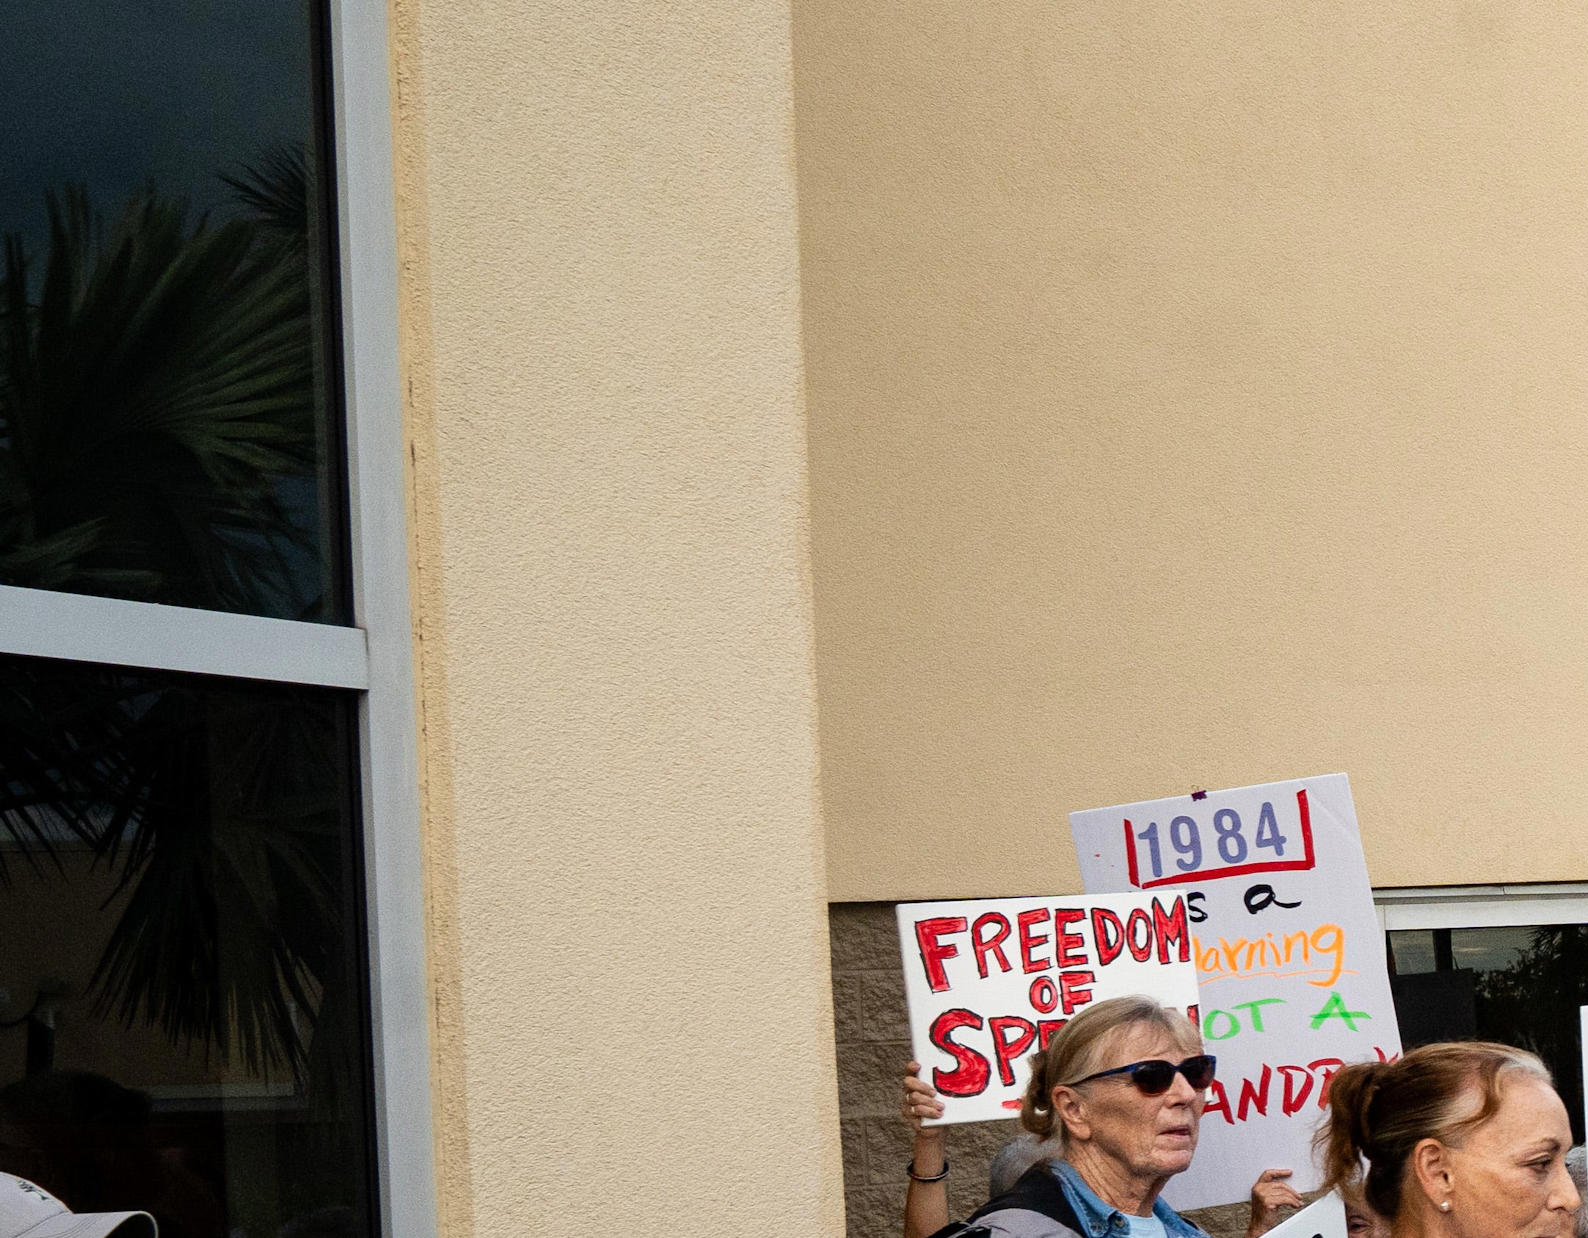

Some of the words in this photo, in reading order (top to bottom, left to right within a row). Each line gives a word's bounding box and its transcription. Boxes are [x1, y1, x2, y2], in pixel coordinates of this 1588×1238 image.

[1137, 801, 1288, 878] 1984
[1243, 883, 1302, 915] a
[915, 896, 1192, 994] FREEDOM
[1029, 970, 1095, 1014] OF
[1308, 991, 1373, 1032] A
